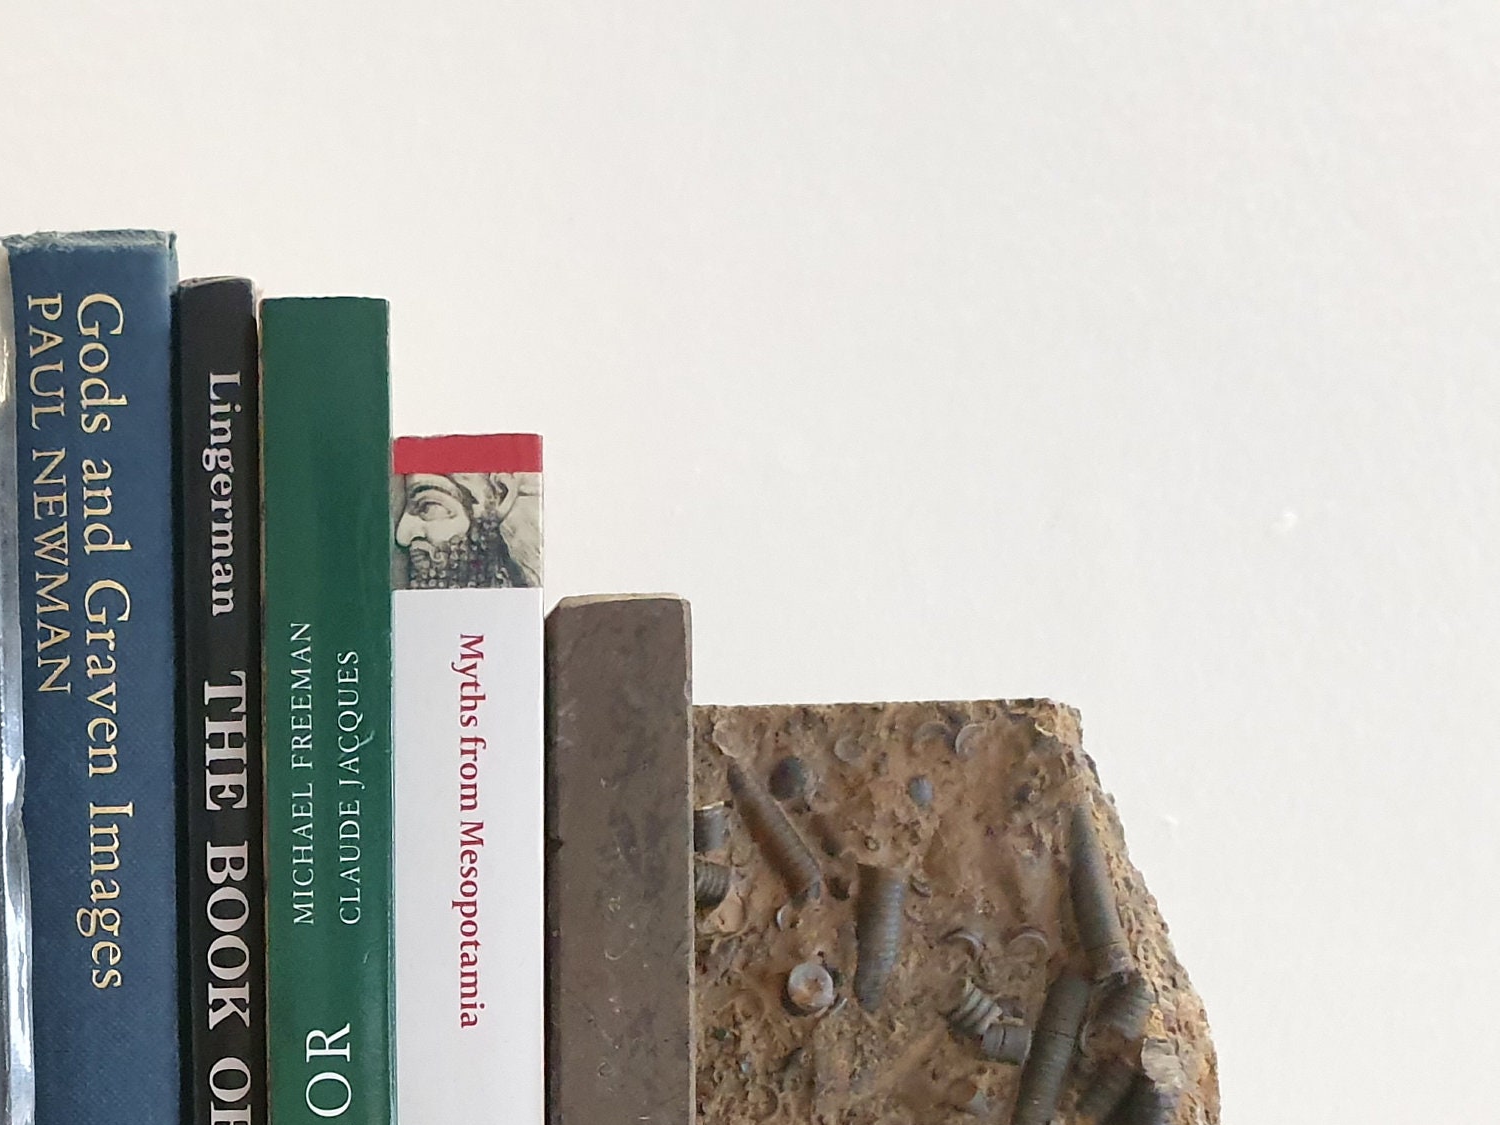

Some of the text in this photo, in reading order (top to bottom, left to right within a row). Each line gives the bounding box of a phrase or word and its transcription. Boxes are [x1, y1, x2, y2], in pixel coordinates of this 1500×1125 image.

[26, 294, 71, 695] PAUL NEWMAN
[201, 372, 240, 616] Lingerman
[75, 293, 135, 990] Gods and Graven Images
[203, 670, 248, 811] THE
[290, 622, 315, 926] MICHAEL FREEMAN
[337, 650, 364, 925] CLAUDE JACQUES
[451, 633, 487, 1029] Myths from Mesopotamia
[205, 840, 251, 1031] BOOK
